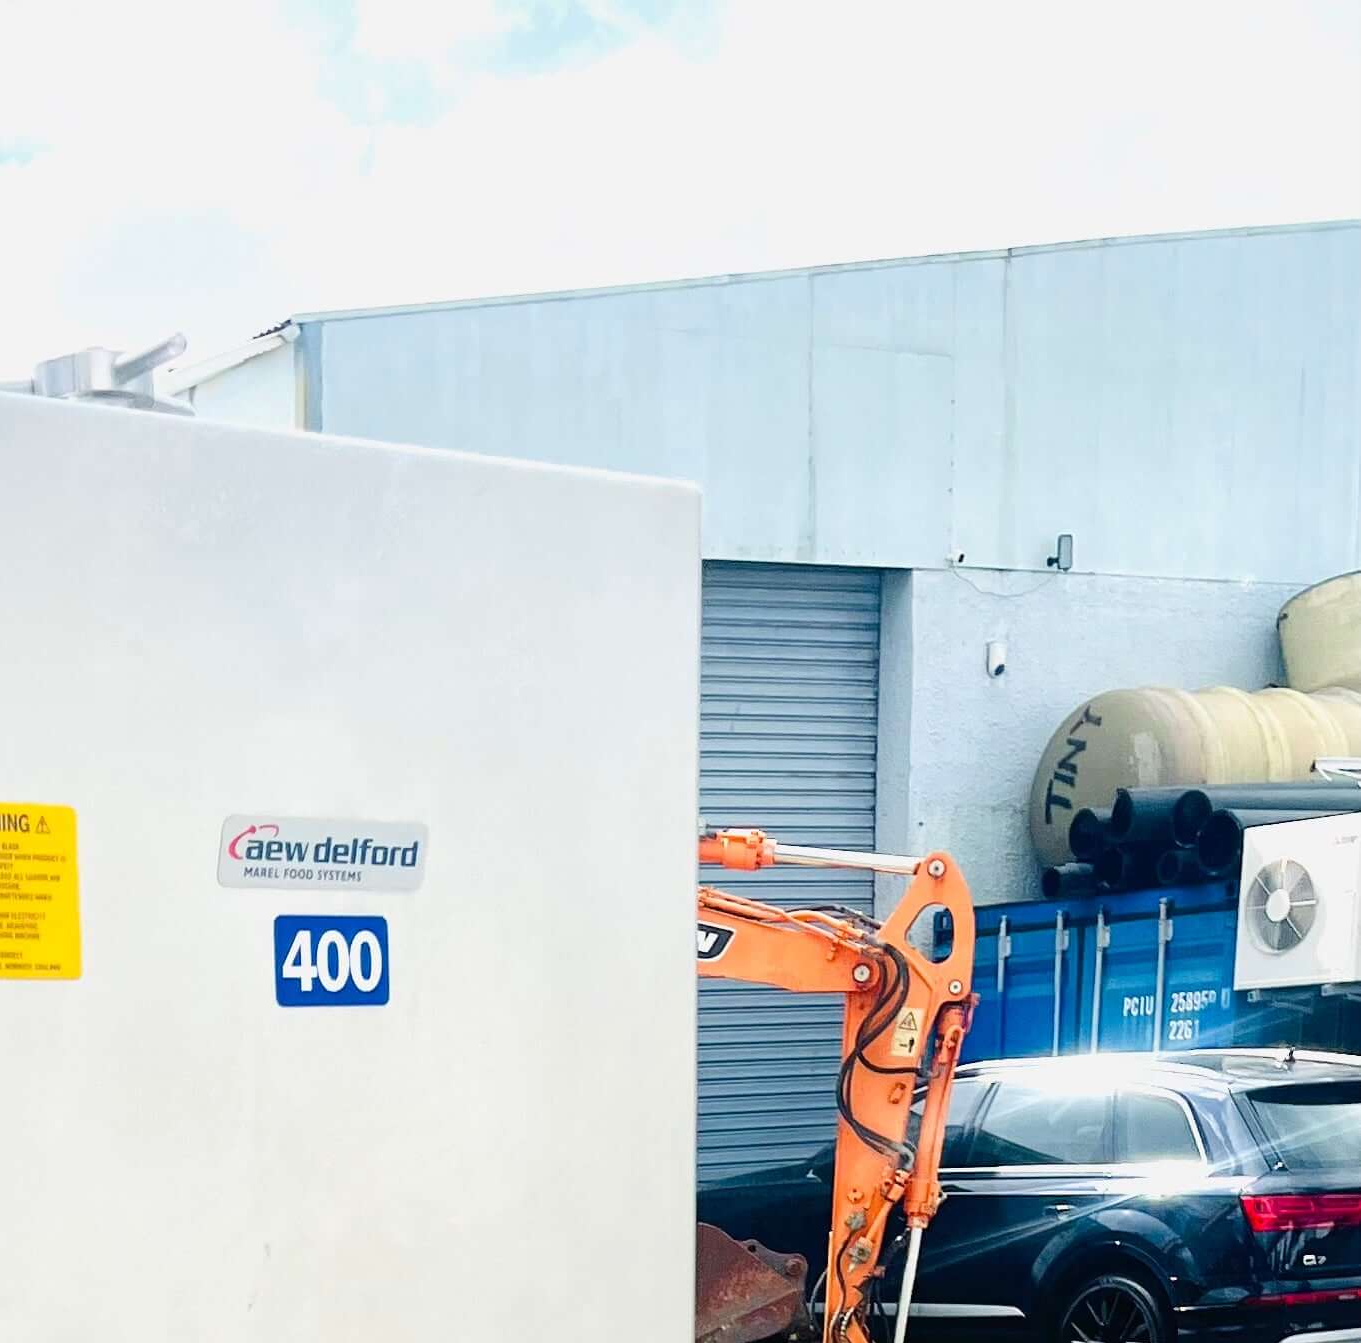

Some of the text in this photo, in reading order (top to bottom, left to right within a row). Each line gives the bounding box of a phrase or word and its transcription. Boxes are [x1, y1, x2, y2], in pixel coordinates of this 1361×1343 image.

[1045, 705, 1102, 825] TINY
[245, 837, 419, 867] aew delford
[243, 867, 362, 882] MAREL FOOD SYSTEMS
[282, 930, 383, 992] 400
[1123, 996, 1154, 1016] PCIU
